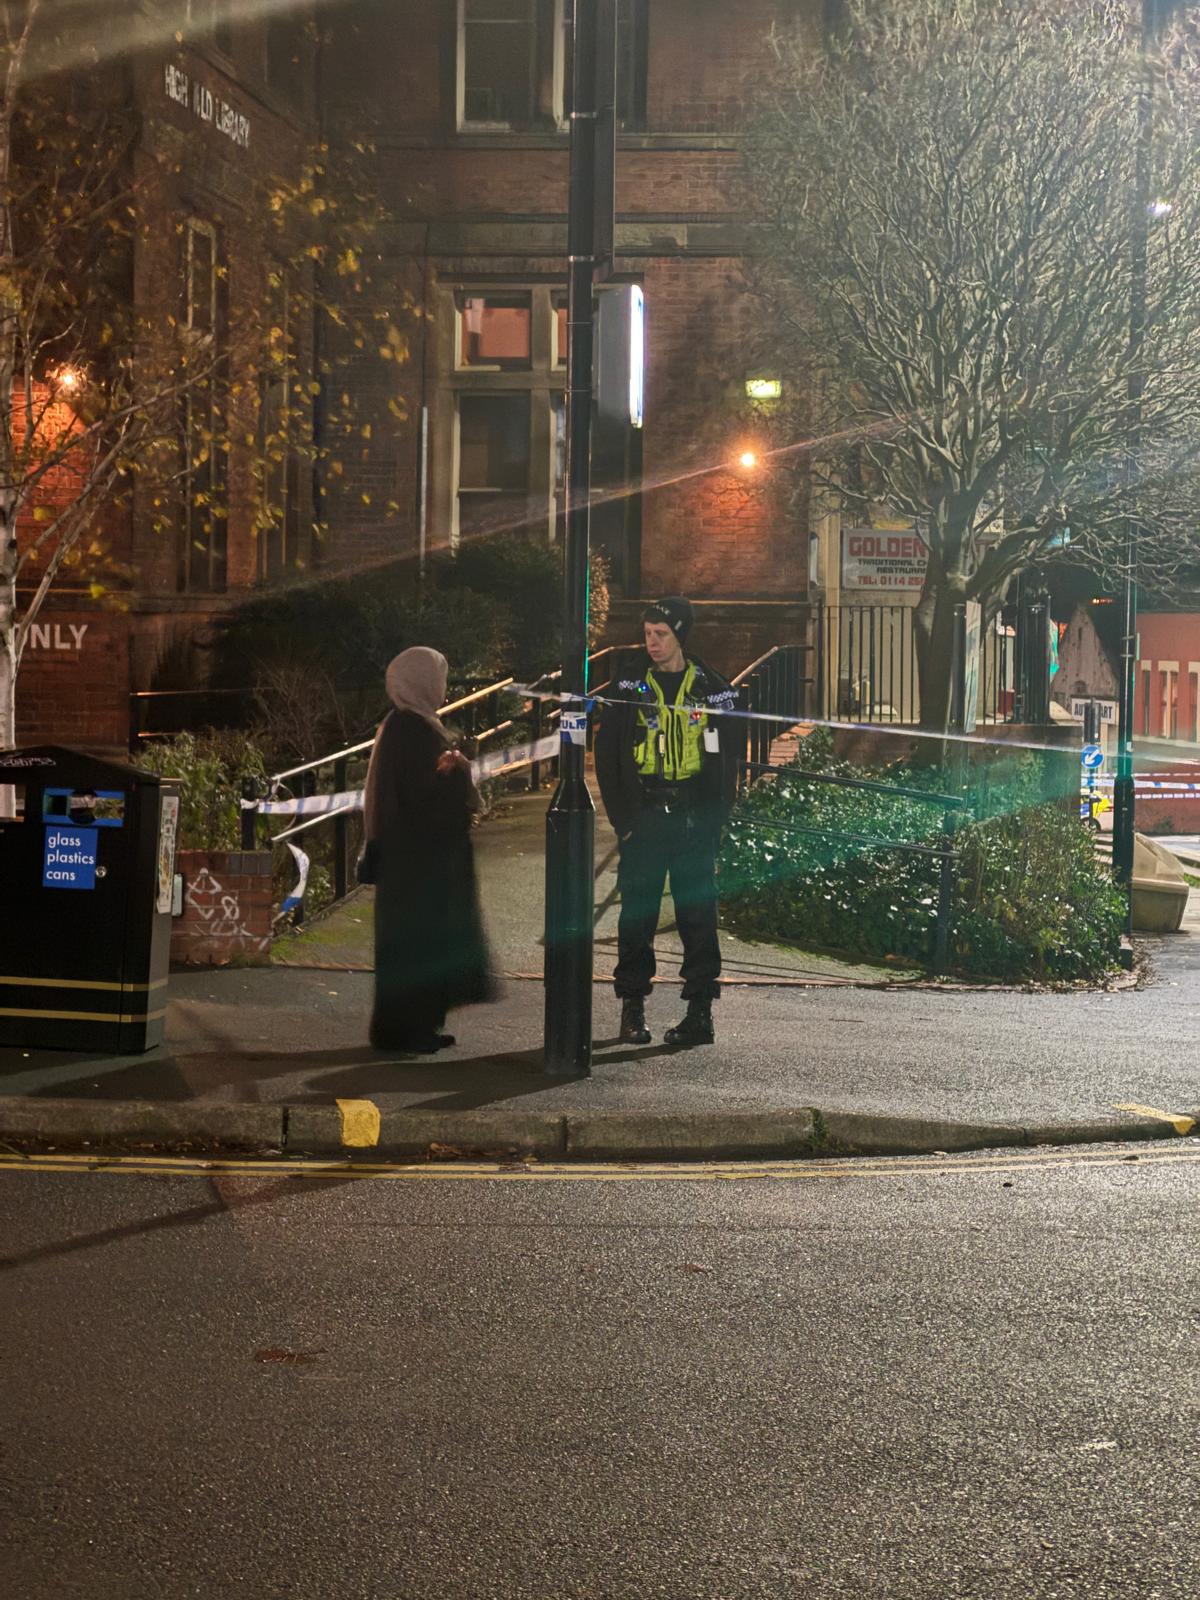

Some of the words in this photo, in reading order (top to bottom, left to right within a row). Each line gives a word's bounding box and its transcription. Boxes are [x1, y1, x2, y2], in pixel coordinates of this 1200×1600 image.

[848, 536, 926, 558] GOLDEN
[48, 832, 81, 848] glass
[47, 849, 94, 865] plastics
[46, 871, 75, 880] cans
